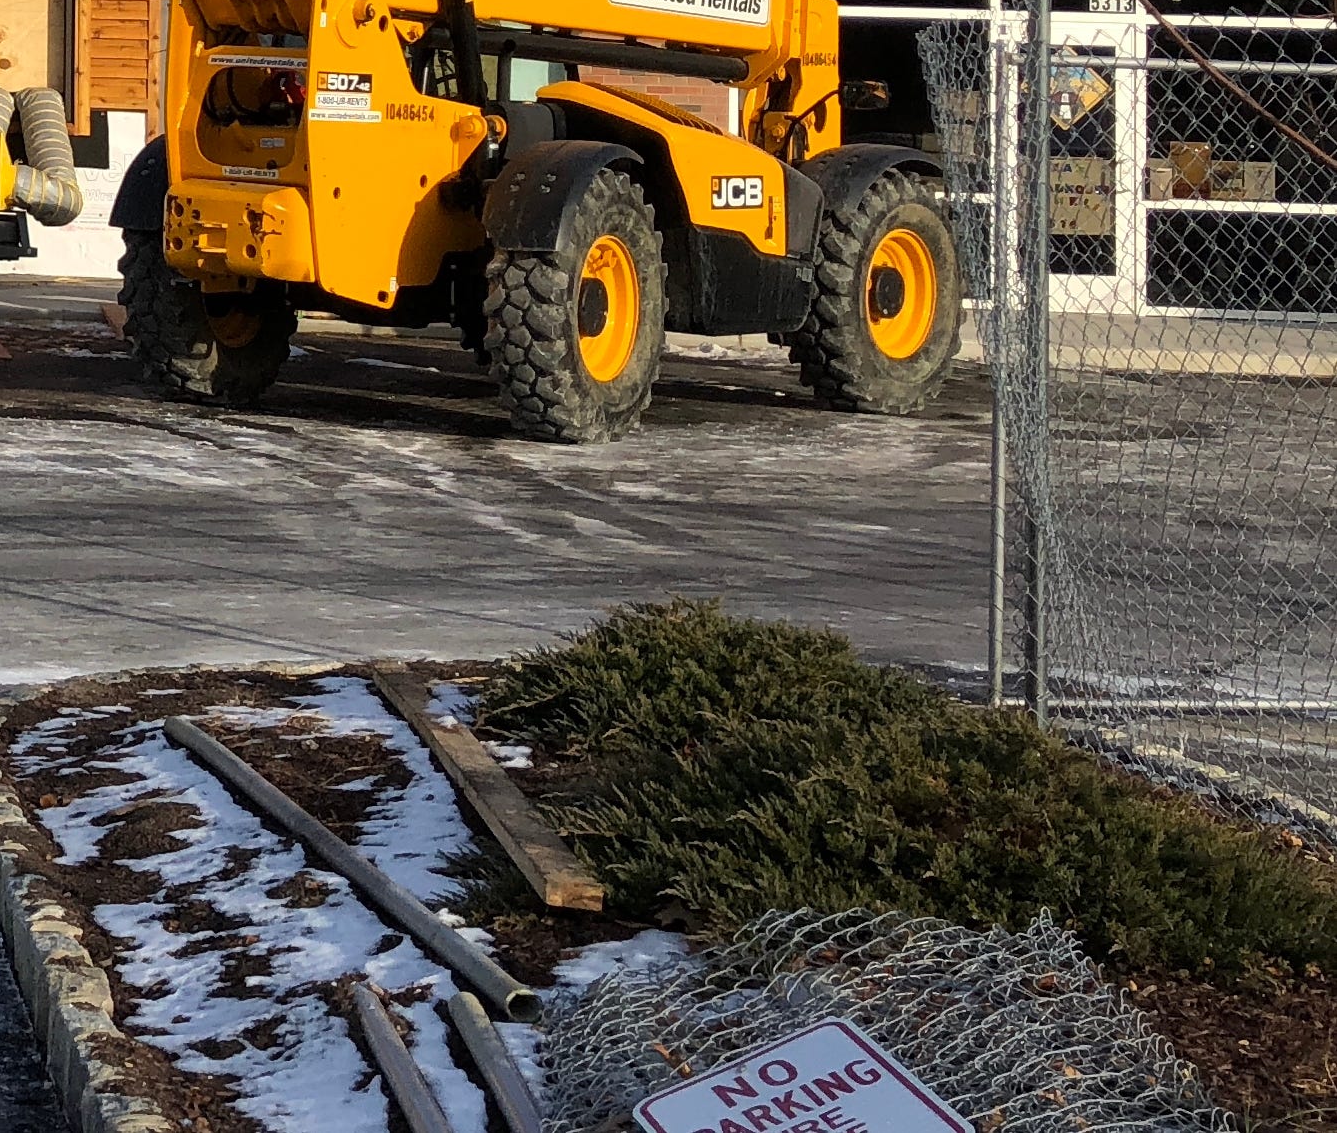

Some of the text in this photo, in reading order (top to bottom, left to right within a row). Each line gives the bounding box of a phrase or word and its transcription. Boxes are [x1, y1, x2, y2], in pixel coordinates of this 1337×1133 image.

[210, 56, 308, 67] www.unitedrentals.co
[327, 73, 370, 91] 507-42
[386, 103, 435, 122] 10486454
[712, 178, 763, 207] JCB
[710, 1058, 799, 1109] NO
[693, 1059, 882, 1133] ARKING
